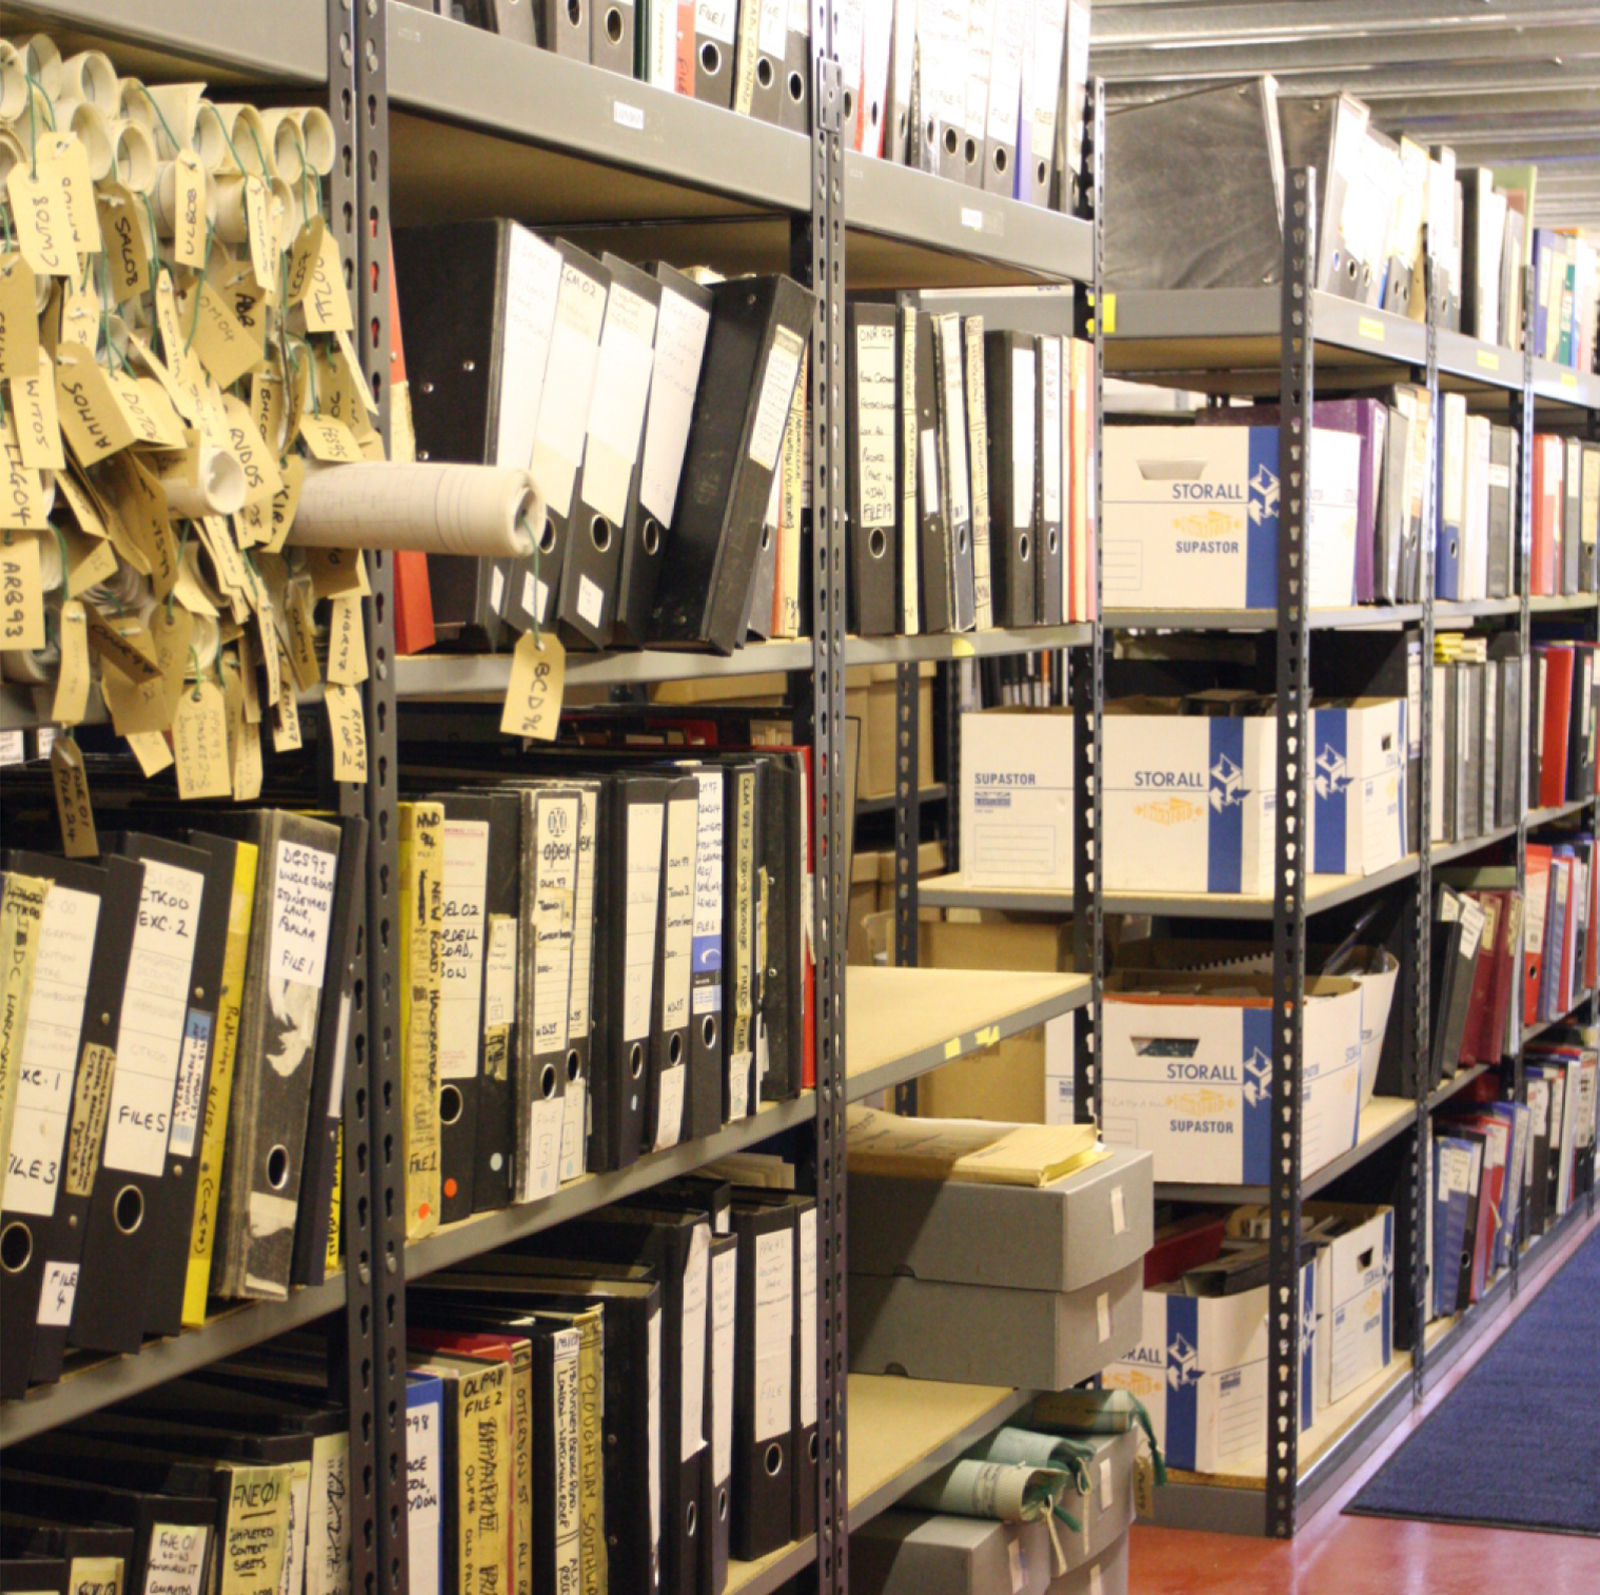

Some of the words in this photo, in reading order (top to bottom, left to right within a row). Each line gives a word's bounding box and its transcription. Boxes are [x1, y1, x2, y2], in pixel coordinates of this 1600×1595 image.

[1172, 483, 1243, 500] STORALL
[1175, 540, 1239, 554] SUPASTOR
[974, 772, 1036, 786] SUPASTOR
[1134, 771, 1204, 788] STORALL
[543, 841, 572, 868] apex
[1166, 1063, 1238, 1081] STORALL
[1169, 1120, 1234, 1134] SUPASTOR
[464, 1396, 491, 1419] FILE
